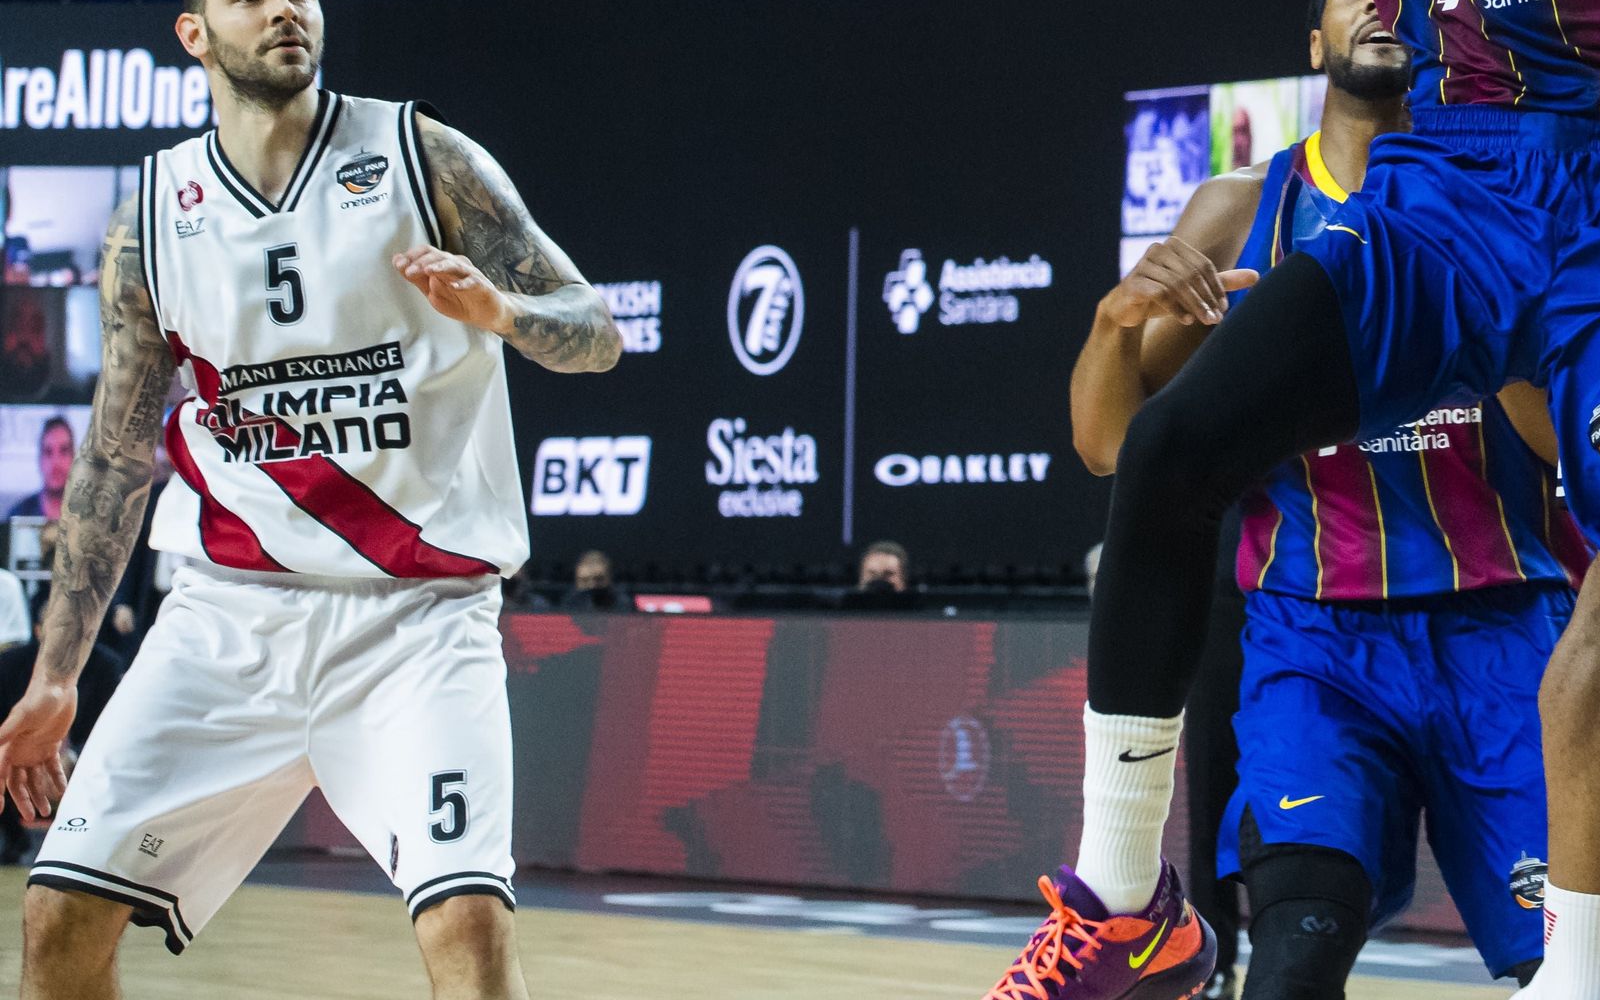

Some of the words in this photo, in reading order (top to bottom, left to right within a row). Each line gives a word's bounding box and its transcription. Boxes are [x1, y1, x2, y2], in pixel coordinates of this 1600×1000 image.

[175, 217, 206, 236] EA7
[264, 243, 307, 327] 5
[285, 346, 401, 379] EXCHANGE
[213, 411, 412, 463] MILANO
[705, 416, 820, 486] Siesta
[542, 456, 640, 495] BKT
[921, 453, 1051, 484] OAKLEY
[428, 769, 471, 845] 5
[140, 833, 164, 852] EA7
